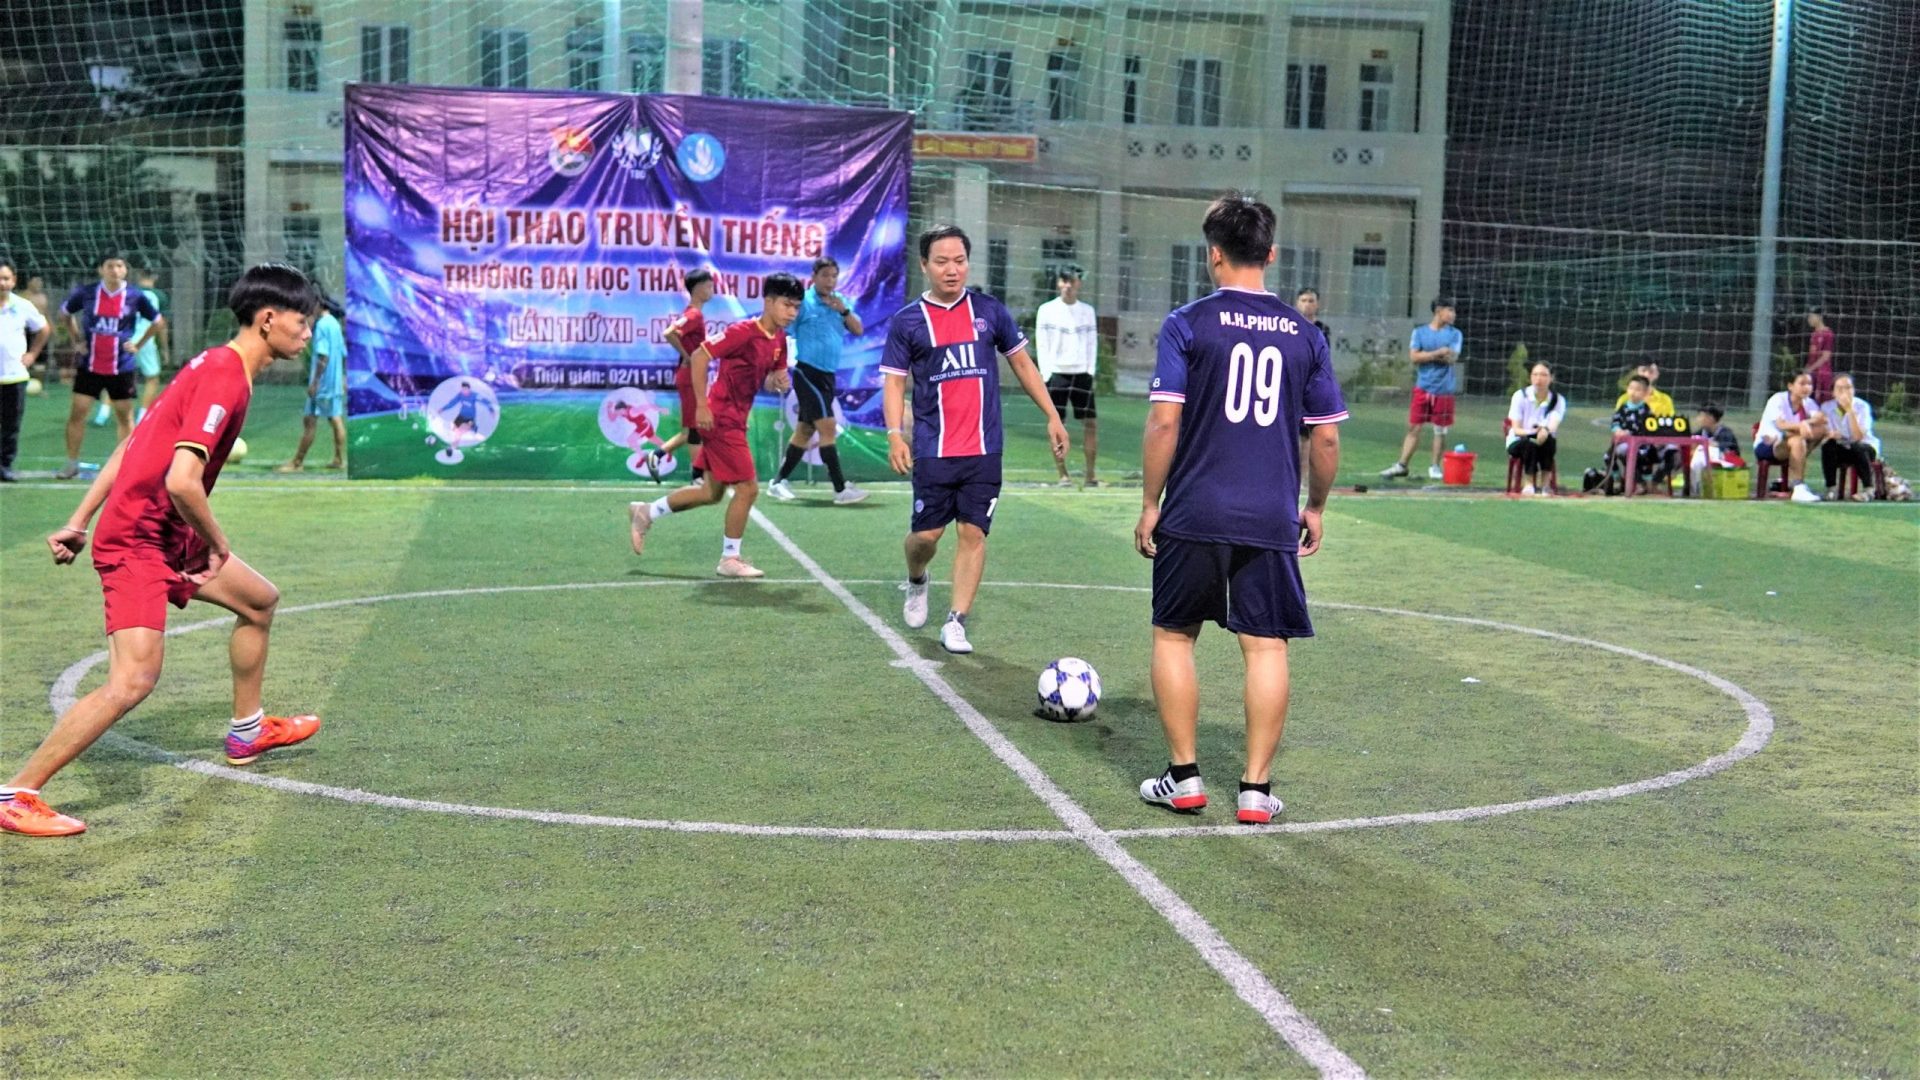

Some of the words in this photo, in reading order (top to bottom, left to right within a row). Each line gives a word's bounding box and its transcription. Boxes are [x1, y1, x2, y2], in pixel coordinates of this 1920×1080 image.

[442, 202, 495, 251] HỘI
[505, 210, 586, 245] THAO
[597, 203, 711, 251] TRUYỀN
[722, 210, 823, 258] THỐNG
[540, 266, 578, 296] ĐẠI
[586, 267, 630, 297] HỌC
[511, 308, 554, 343] LẦN
[557, 311, 601, 343] THỨ
[602, 317, 634, 344] XII
[1224, 342, 1283, 427] 09
